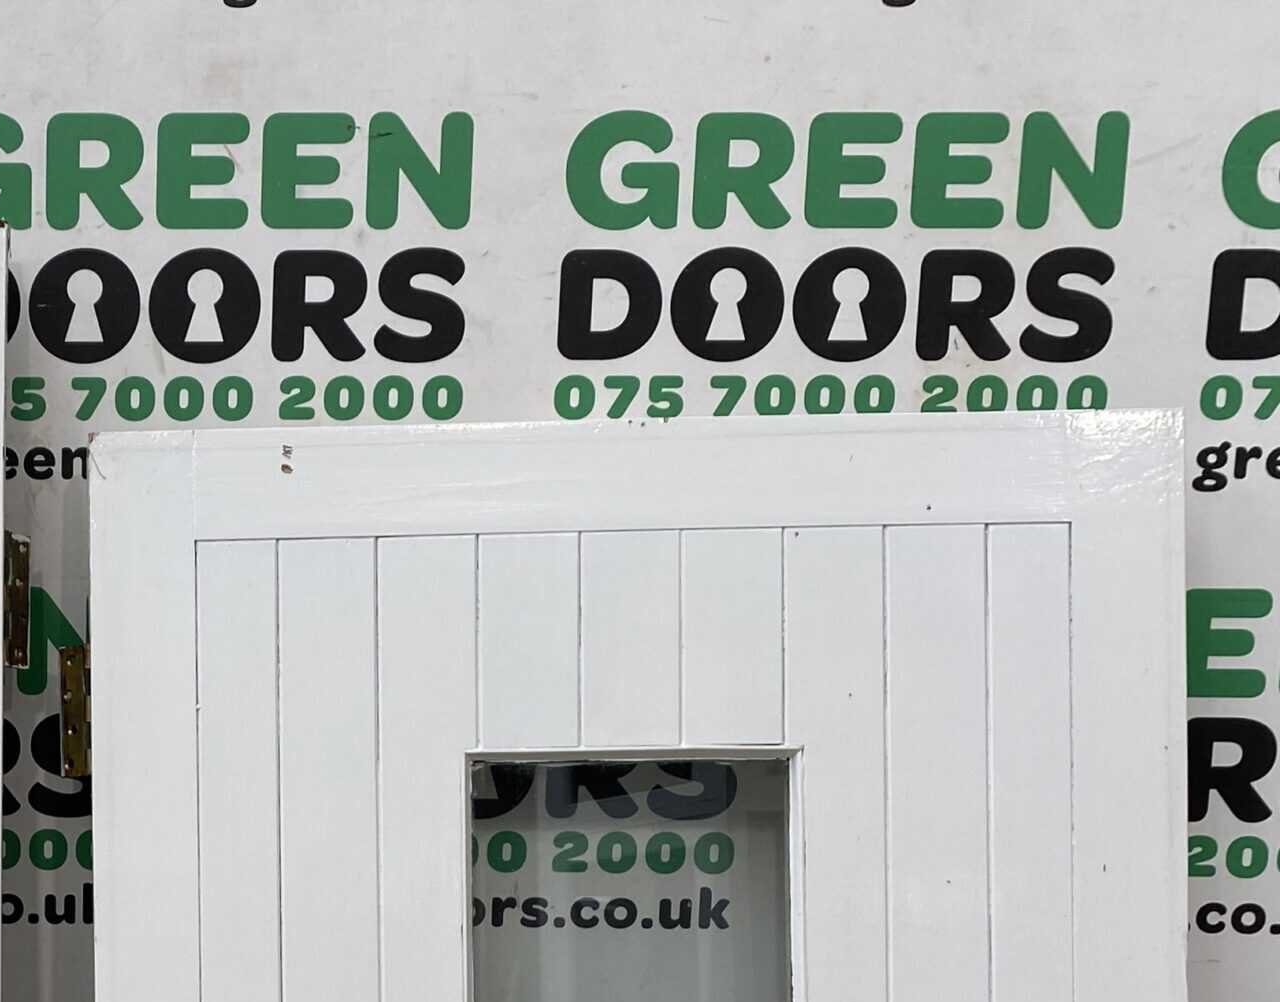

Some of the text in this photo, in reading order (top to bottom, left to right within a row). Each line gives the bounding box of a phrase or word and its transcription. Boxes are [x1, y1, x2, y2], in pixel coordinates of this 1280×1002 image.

[565, 110, 1131, 231] GREEN
[7, 247, 466, 365] OORS
[557, 246, 1115, 363] DOORS
[71, 375, 254, 422] 7000
[278, 375, 464, 422] 2000
[553, 374, 1108, 421] 075 7000 2000
[552, 831, 734, 875] 2000
[1188, 835, 1280, 880] 20
